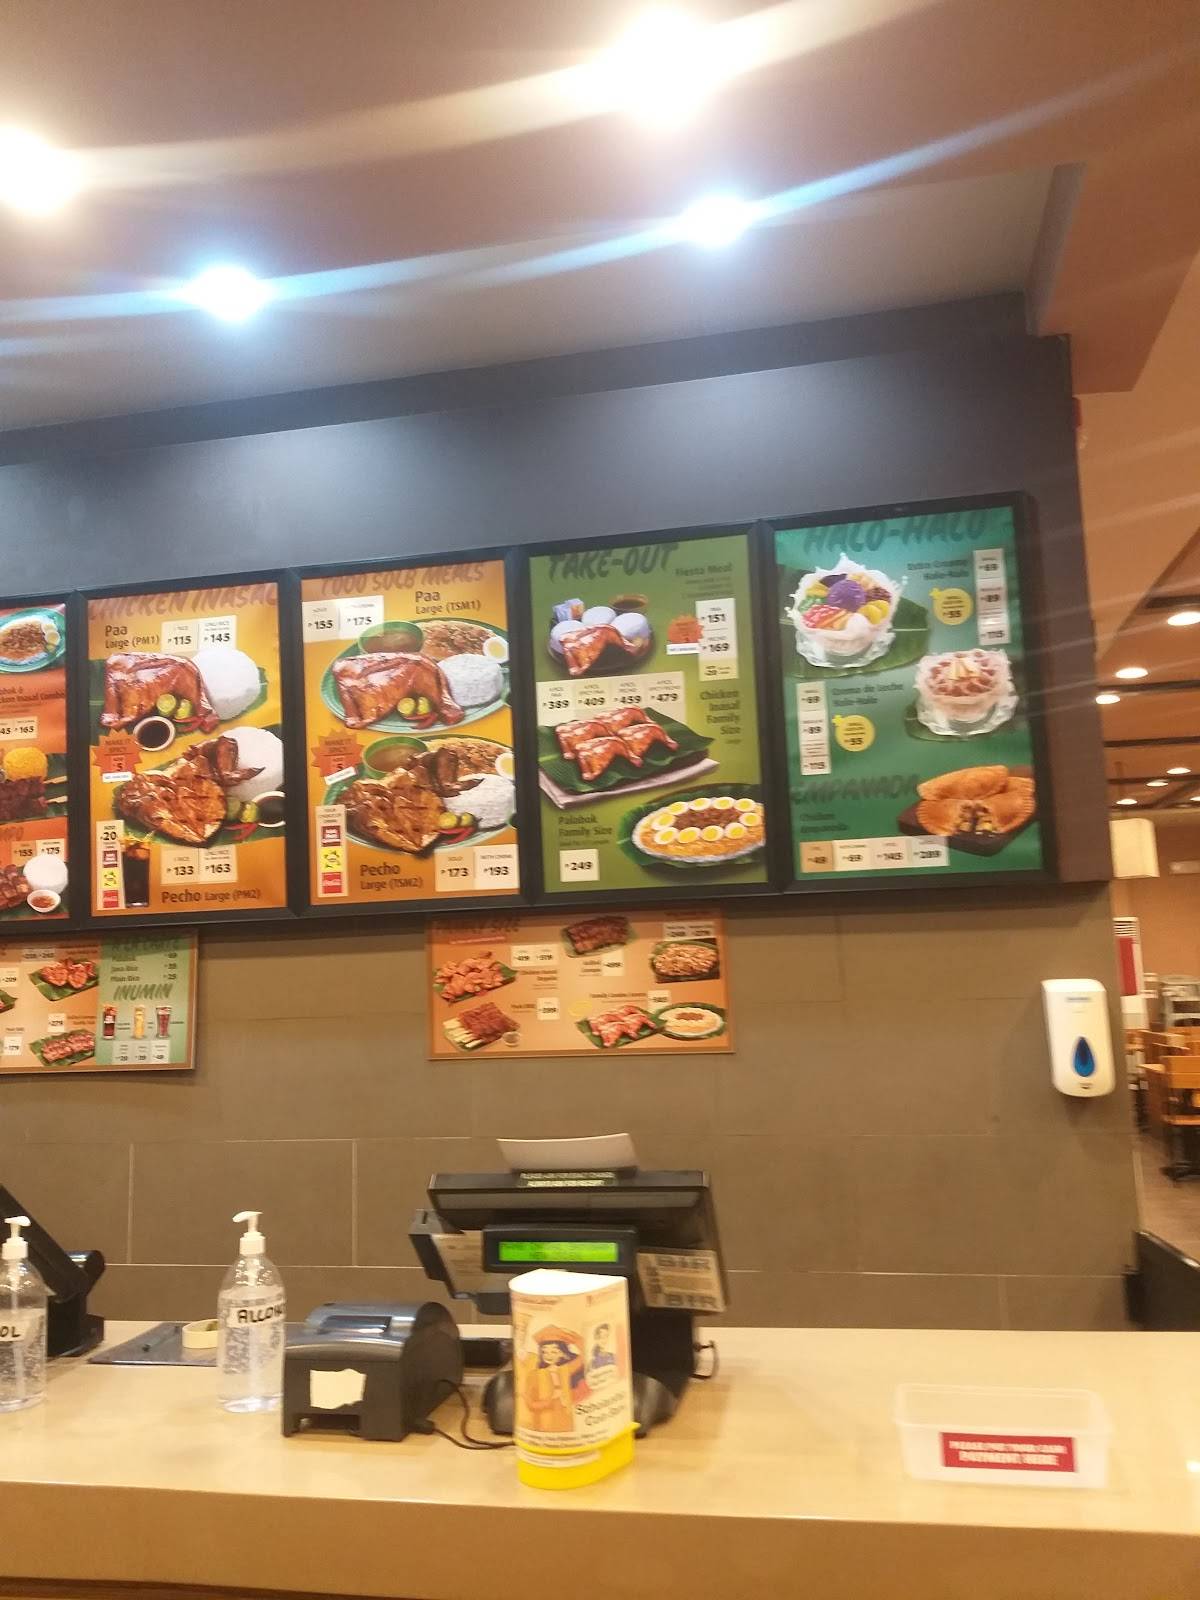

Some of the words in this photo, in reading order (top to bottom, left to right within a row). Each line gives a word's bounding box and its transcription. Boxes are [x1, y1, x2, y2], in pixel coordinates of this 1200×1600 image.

[549, 543, 679, 579] TAKE-OUT
[415, 590, 441, 603] Paa
[416, 604, 444, 615] Large
[446, 600, 481, 613] (TSM1)
[104, 624, 128, 637] Paa
[105, 640, 130, 650] Large
[132, 634, 160, 648] (PM1)
[720, 726, 742, 736] Size
[360, 862, 400, 877] Pecho
[360, 880, 387, 892] Large
[161, 888, 201, 904] Pecho
[204, 891, 231, 902] Large
[112, 984, 174, 1001] INUMIN
